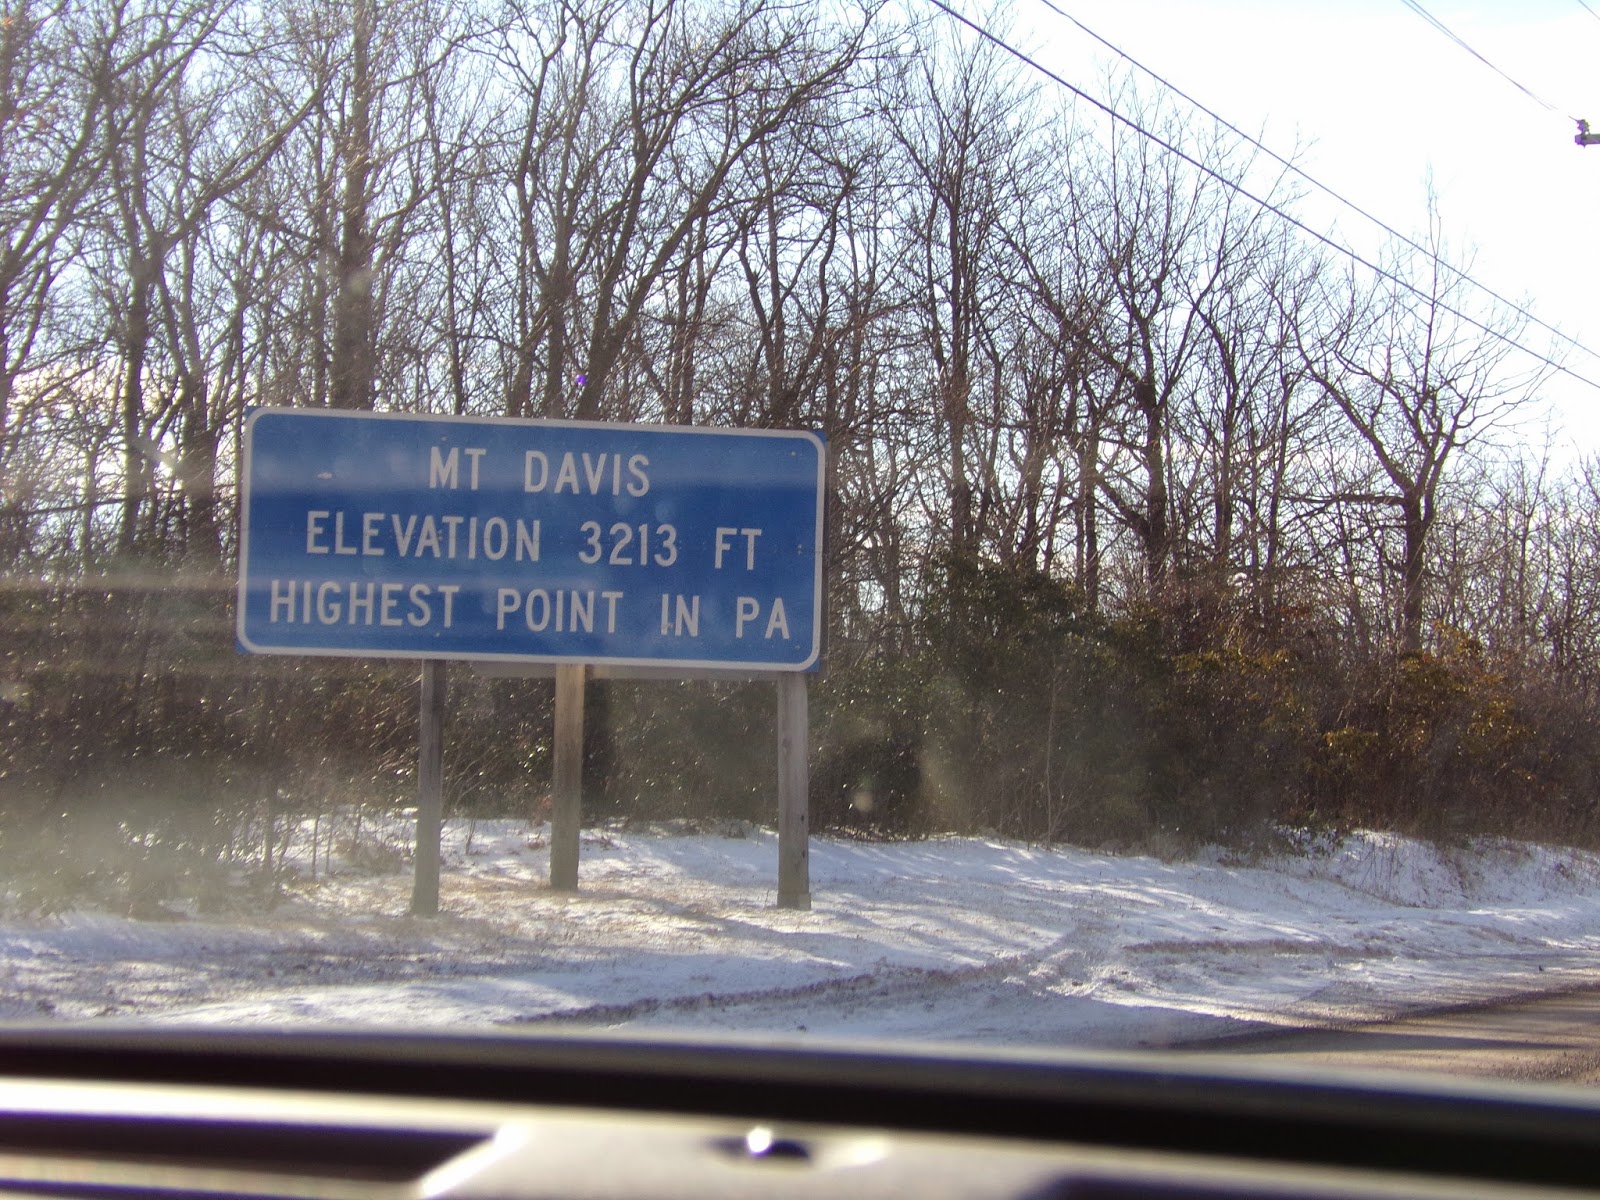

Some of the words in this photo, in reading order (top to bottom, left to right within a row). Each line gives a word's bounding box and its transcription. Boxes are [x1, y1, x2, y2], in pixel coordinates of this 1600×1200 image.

[429, 446, 487, 490] MT
[524, 450, 650, 497] DAVIS
[306, 510, 541, 563] ELEVATION
[579, 520, 678, 567] 3213
[715, 526, 763, 571] FT
[270, 579, 460, 628] HIGHEST
[496, 588, 624, 634] POINT
[660, 594, 700, 637] IN
[735, 597, 791, 641] PA
